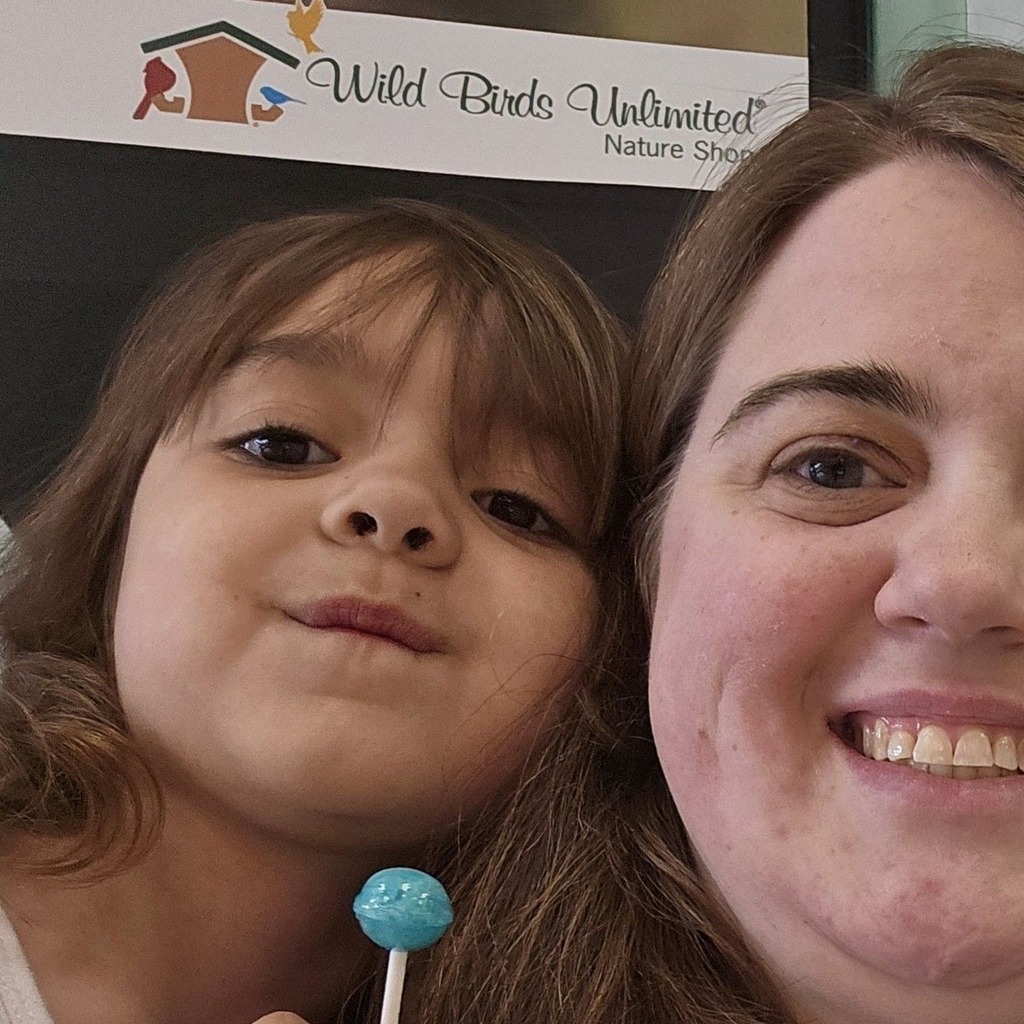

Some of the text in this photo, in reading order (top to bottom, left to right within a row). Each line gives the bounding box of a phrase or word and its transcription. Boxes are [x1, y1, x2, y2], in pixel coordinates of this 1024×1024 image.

[305, 57, 427, 109] Wild
[438, 70, 554, 120] Birds
[604, 133, 685, 160] Nature
